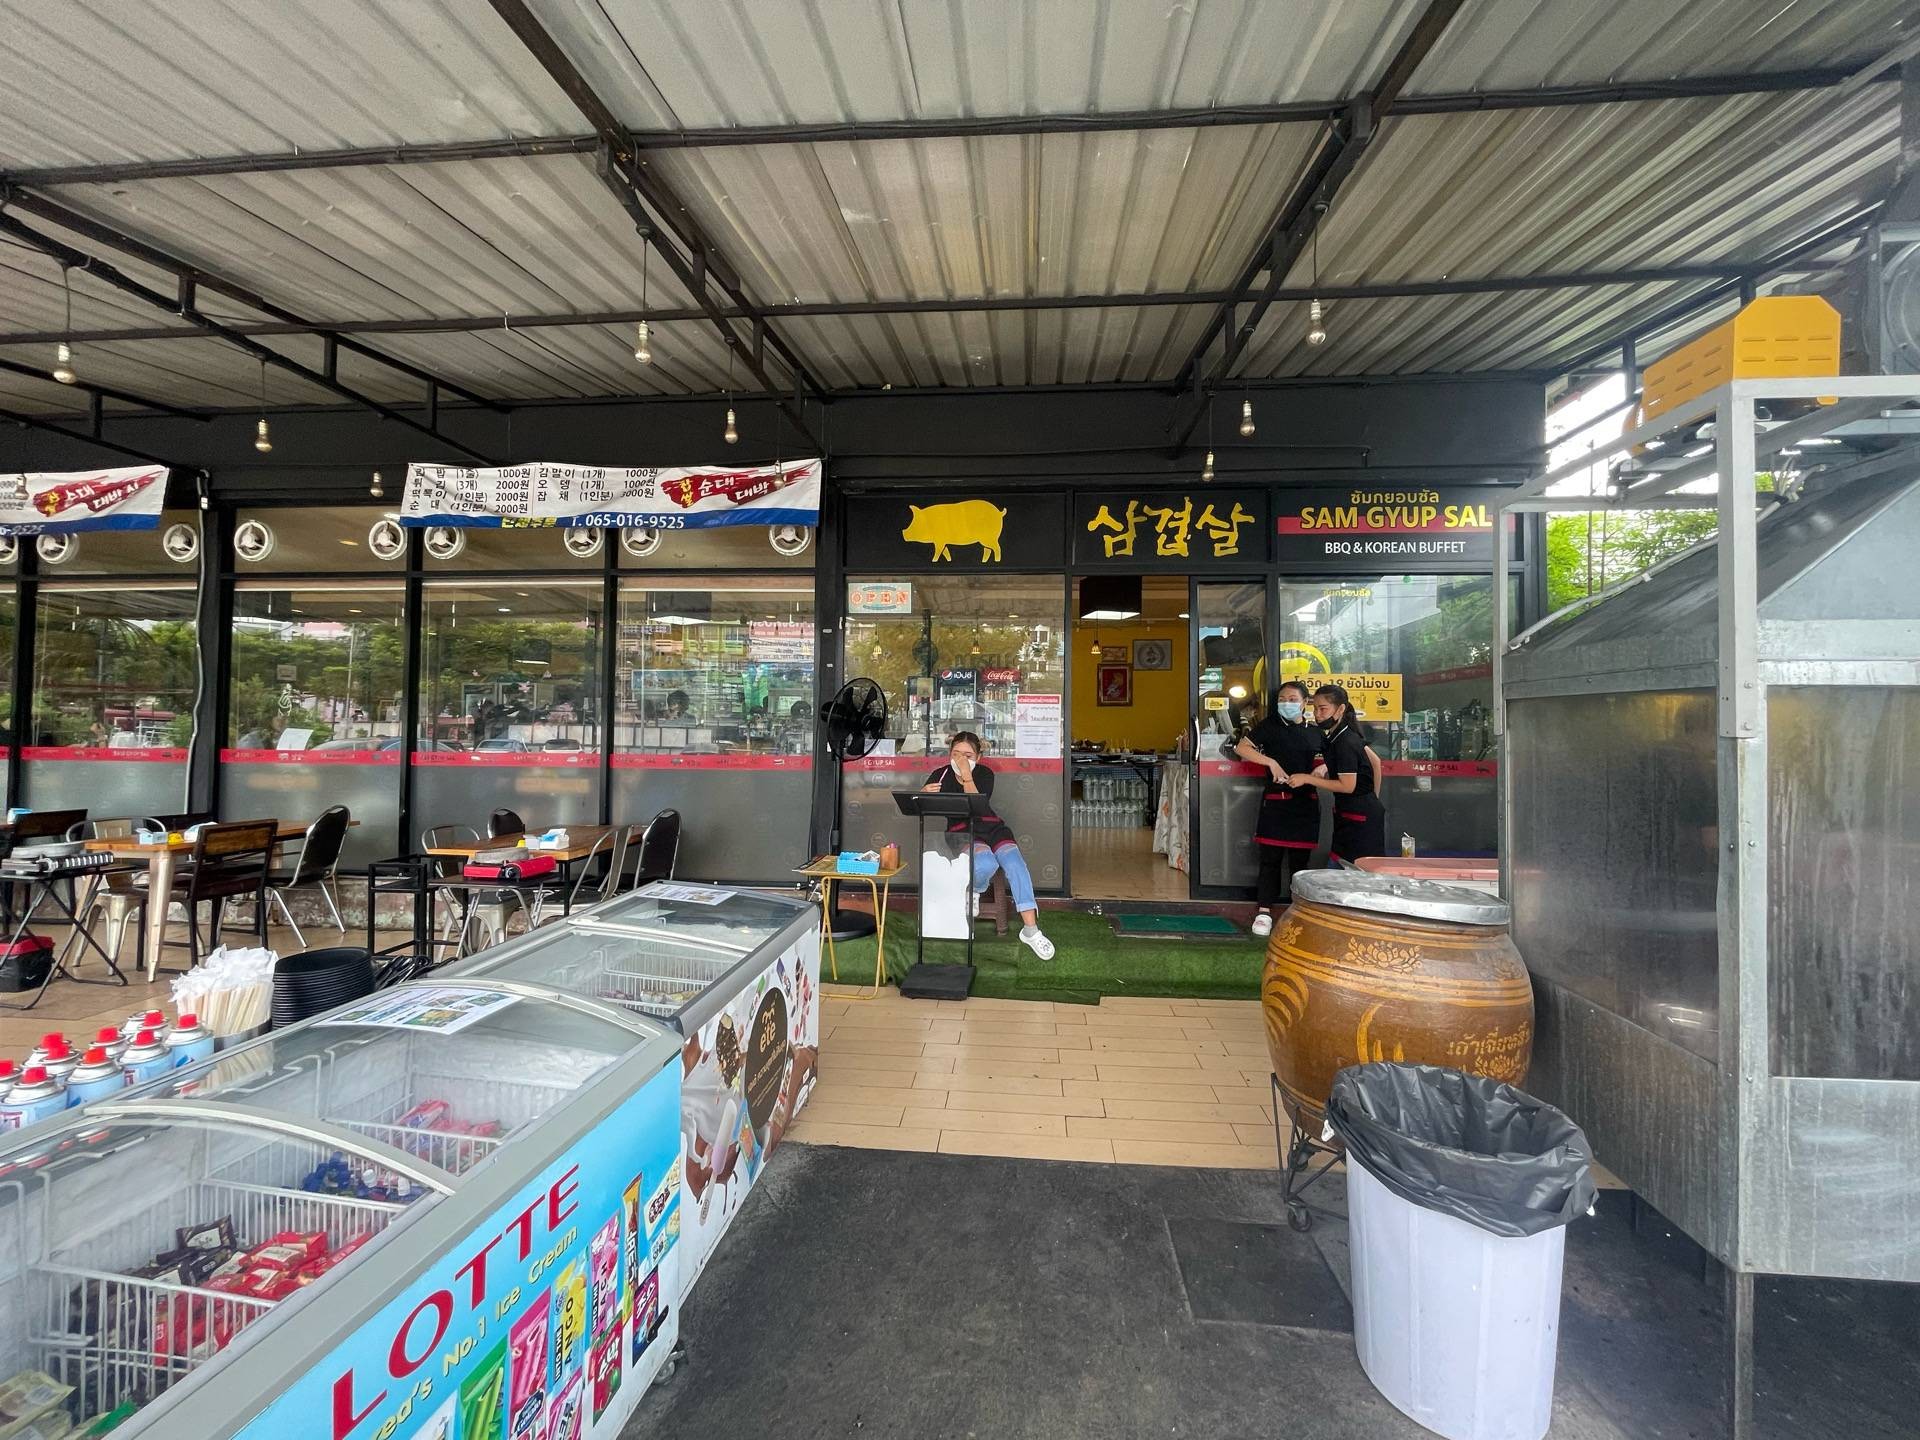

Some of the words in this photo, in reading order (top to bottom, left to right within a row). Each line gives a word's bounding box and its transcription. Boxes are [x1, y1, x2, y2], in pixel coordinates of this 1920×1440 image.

[497, 468, 531, 479] 1000원
[496, 479, 530, 490] 2000원
[697, 477, 735, 497] 순대
[496, 491, 529, 502] 2000원
[494, 503, 528, 514] 2000원
[585, 514, 685, 530] 065-016-9525
[1301, 506, 1359, 529] SAM
[1366, 506, 1437, 529] GYUP
[1444, 505, 1493, 529] SAL
[1325, 541, 1352, 555] BBQ
[1353, 542, 1363, 554] &
[1365, 541, 1418, 554] KOREAN
[1419, 541, 1466, 554] BUFFET
[850, 591, 909, 605] OPEN
[1346, 675, 1391, 689] ยังไม่จบ
[496, 1285, 521, 1323] Ice
[528, 1226, 578, 1285] Cream
[333, 1163, 580, 1440] LOTTE
